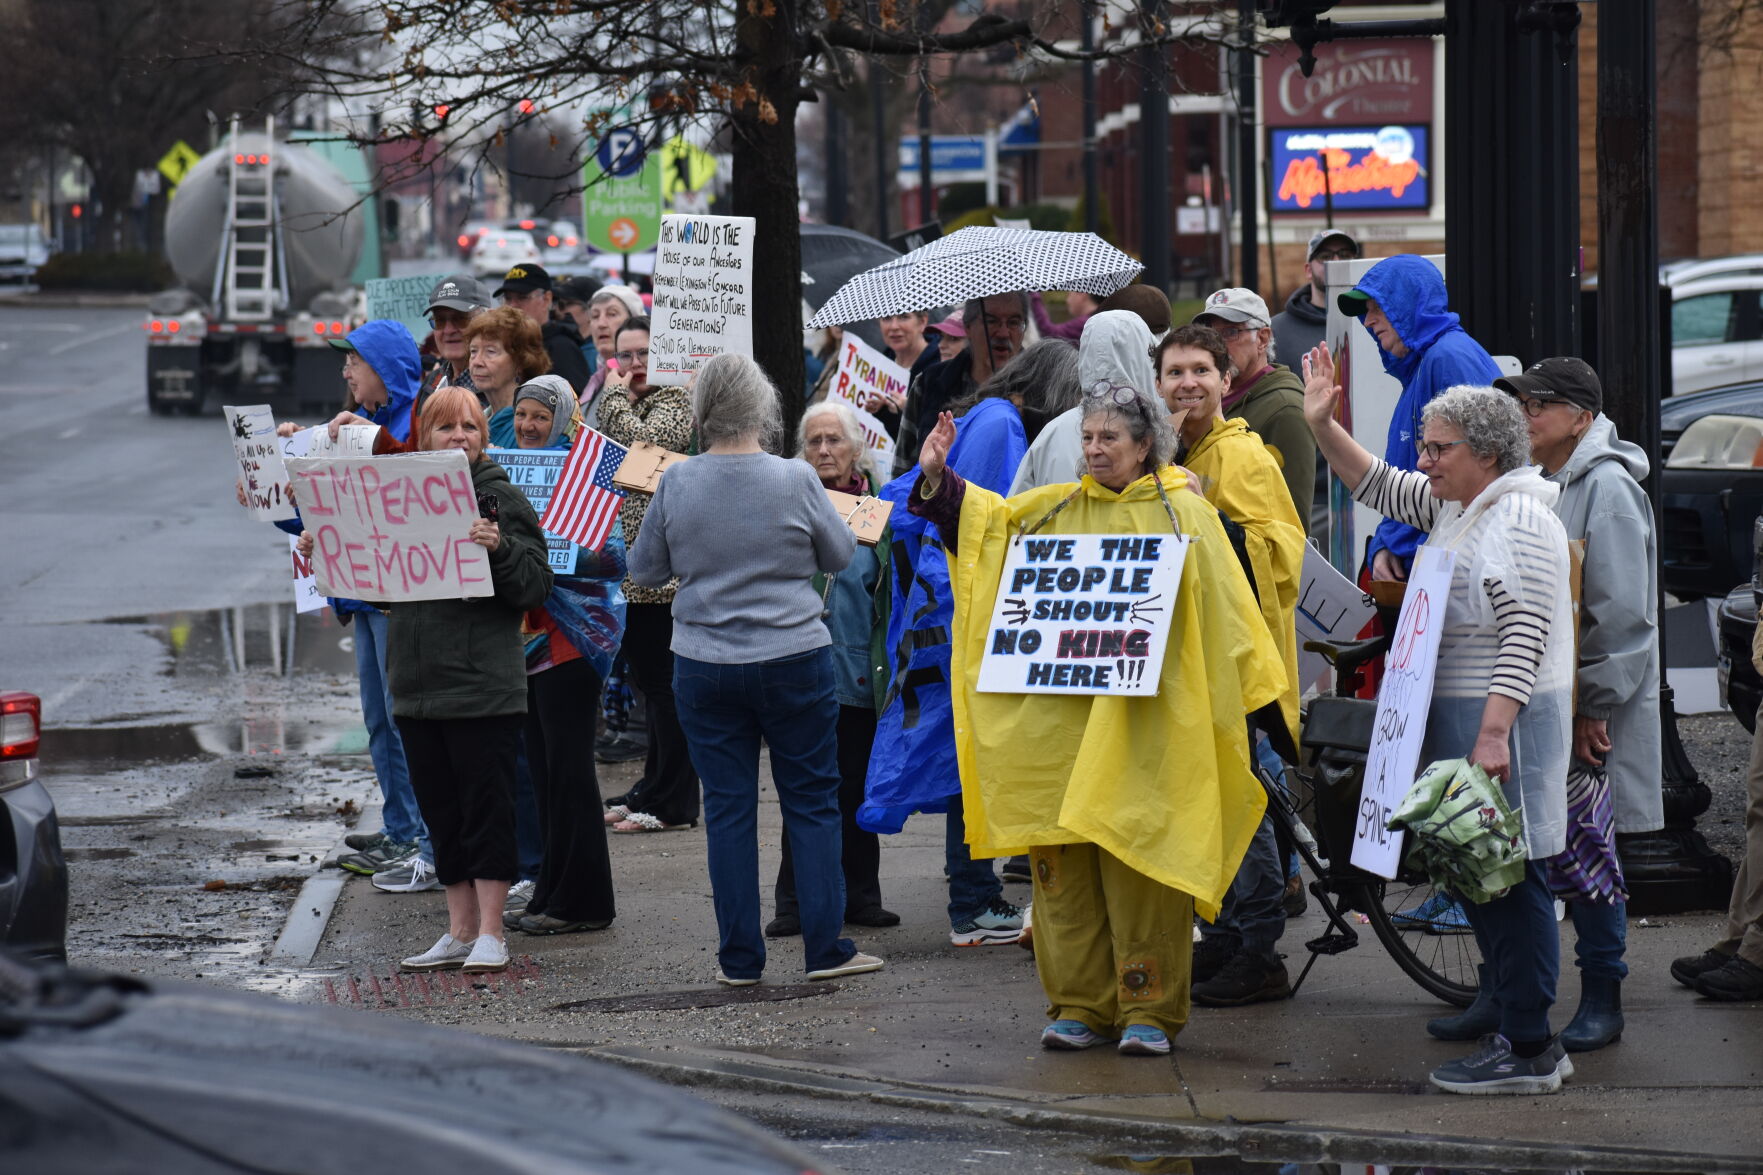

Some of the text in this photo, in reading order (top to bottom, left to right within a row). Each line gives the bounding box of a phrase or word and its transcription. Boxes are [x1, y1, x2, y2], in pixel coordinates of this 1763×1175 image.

[609, 133, 637, 171] P
[590, 200, 657, 218] Parking
[661, 218, 741, 246] THIS WORLD IS THE
[663, 247, 742, 269] HOUSE OF OUR ANCESTORS
[712, 273, 743, 295] CONCORD
[653, 290, 669, 309] WHAT
[720, 292, 746, 316] FUTURE
[846, 343, 906, 394] TYRANNY
[505, 466, 535, 484] OVE
[514, 456, 541, 465] PEOPLE
[544, 457, 558, 466] ARE
[296, 464, 477, 525] IMPEACH
[318, 525, 486, 594] REMOVE
[1025, 537, 1164, 564] WE THE
[1010, 566, 1153, 594] PEOPLE
[1032, 598, 1130, 622] SHOUT
[991, 628, 1151, 658] NO KING
[1377, 707, 1409, 745] GROW
[1377, 756, 1387, 795] A
